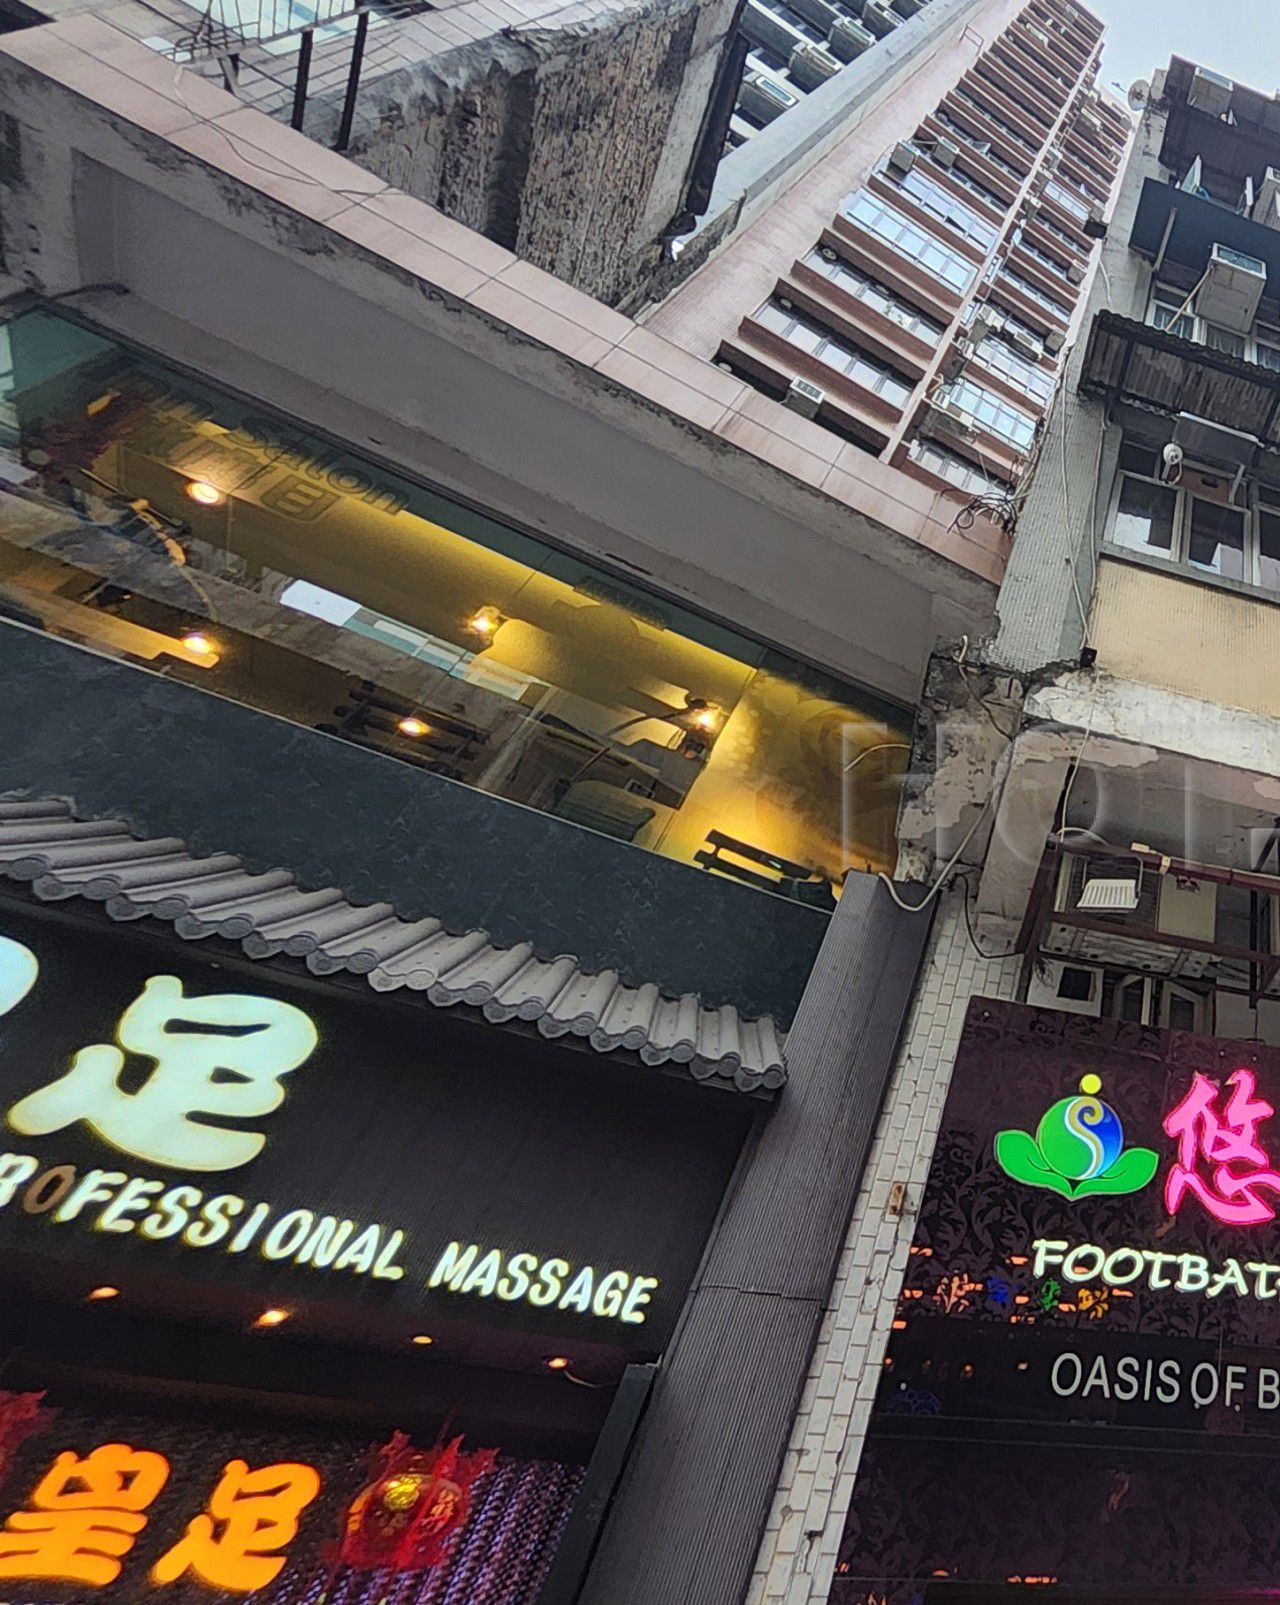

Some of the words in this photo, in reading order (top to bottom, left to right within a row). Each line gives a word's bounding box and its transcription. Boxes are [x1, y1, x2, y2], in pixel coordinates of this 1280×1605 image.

[428, 1241, 659, 1324] MASSAGE
[1051, 1352, 1181, 1404] OASIS
[1190, 1362, 1247, 1410] OF
